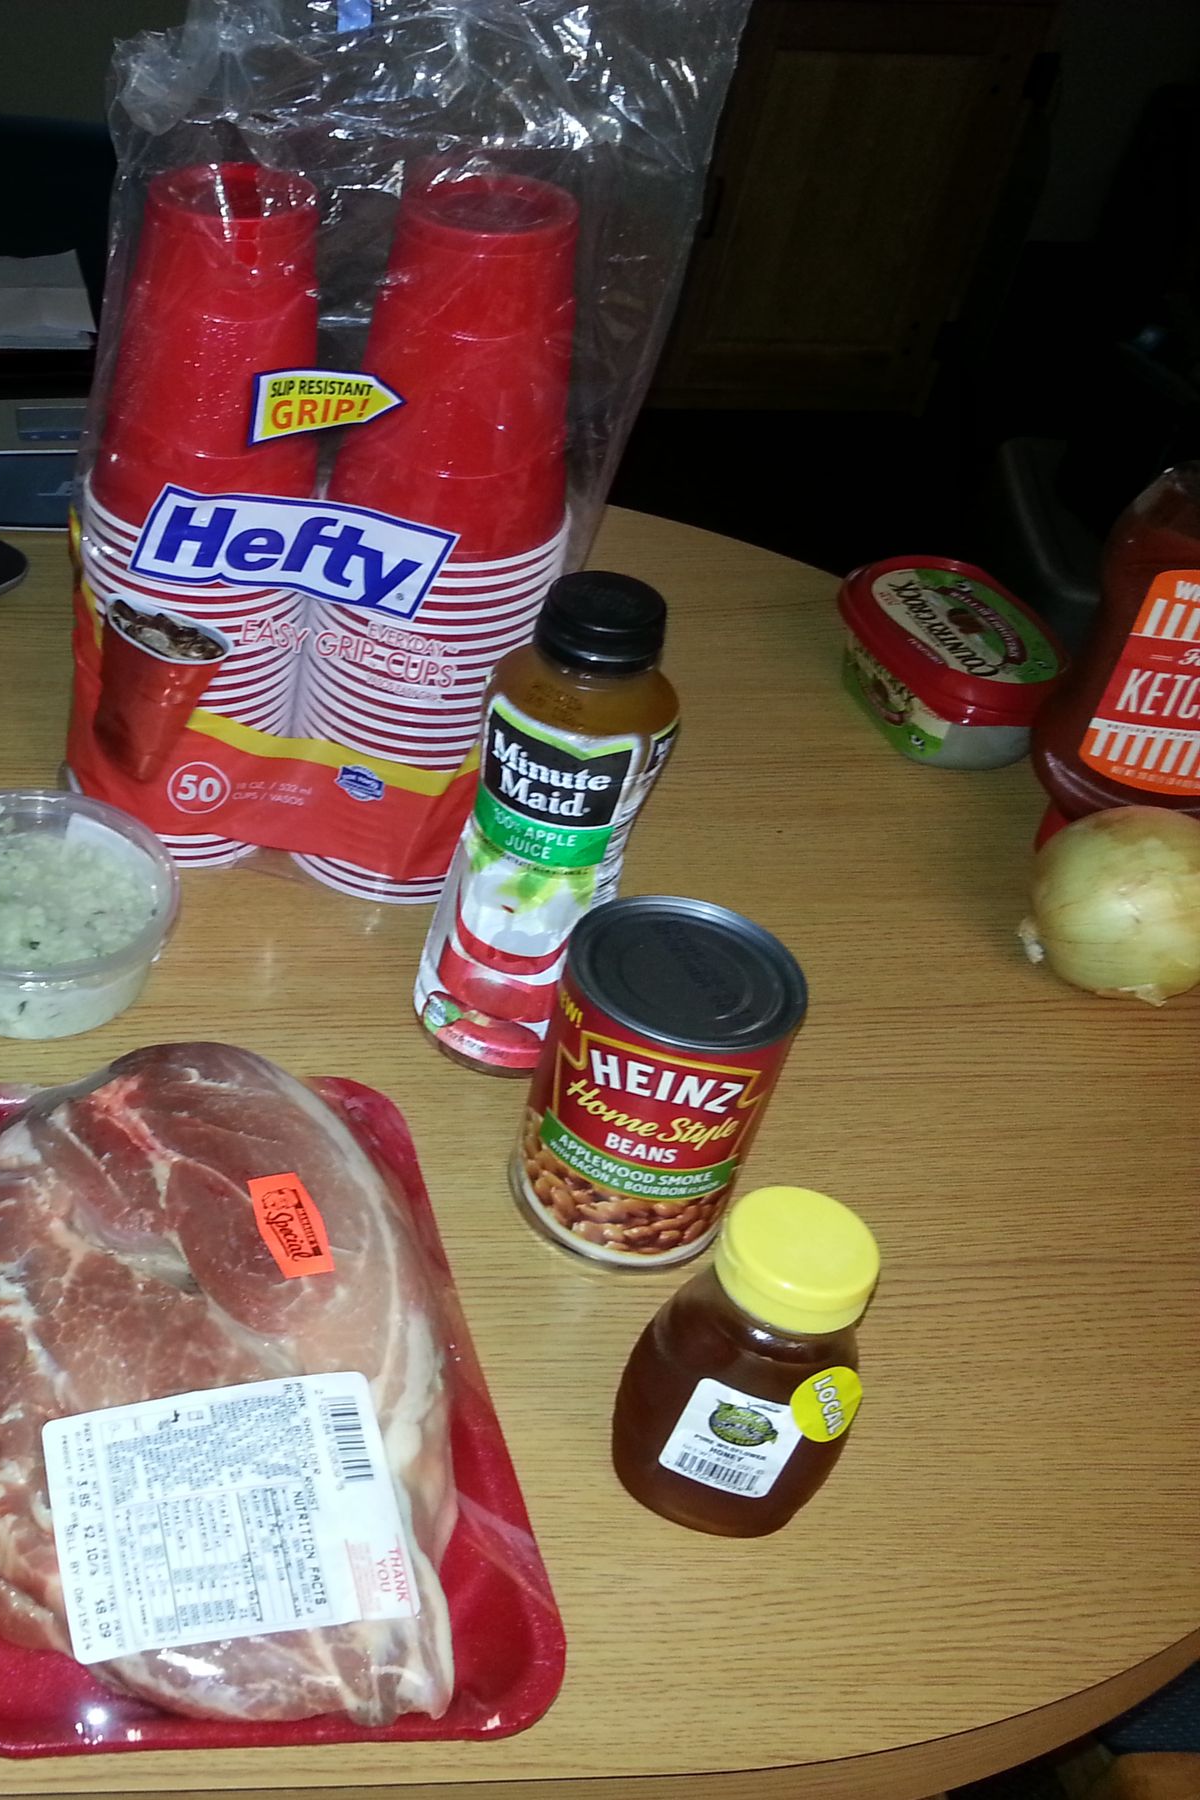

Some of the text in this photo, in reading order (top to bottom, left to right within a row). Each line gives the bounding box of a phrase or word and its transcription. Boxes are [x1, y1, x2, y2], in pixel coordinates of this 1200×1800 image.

[271, 380, 373, 397] SLIP RESISTANT
[271, 398, 369, 430] GRIP!
[155, 505, 423, 606] Hefty
[888, 580, 936, 622] CROCK
[240, 618, 457, 688] EASY GRIP CUPS
[367, 621, 446, 657] EVERYDAY
[927, 621, 999, 677] COUNTRY
[1115, 668, 1200, 719] KETC
[492, 729, 611, 791] Minute
[176, 774, 222, 803] 50
[499, 765, 585, 817] Maid
[505, 834, 551, 860] JUICE
[524, 827, 578, 847] APPLE
[590, 1049, 745, 1114] HEINZ
[566, 1078, 740, 1151] Home Style
[559, 1134, 713, 1186] APPLEWOOD SMOKE
[605, 1132, 678, 1164] BEANS
[569, 1157, 609, 1183] BACON
[623, 1180, 688, 1196] BOURBON
[264, 1212, 313, 1262] Special
[813, 1374, 846, 1436] LOCAL
[293, 1381, 321, 1476] PORK SHOULDER
[710, 1446, 745, 1462] HONEY
[75, 1479, 91, 1507] 3.85
[303, 1475, 320, 1512] ROAST
[61, 1523, 78, 1553] SELL
[292, 1490, 327, 1605] NUTRITION FACTS
[99, 1547, 112, 1577] PRICE
[375, 1558, 391, 1592] YOU
[388, 1546, 411, 1602] THANK
[93, 1598, 112, 1639] $8.09
[106, 1583, 125, 1649] TOTAL PRICE
